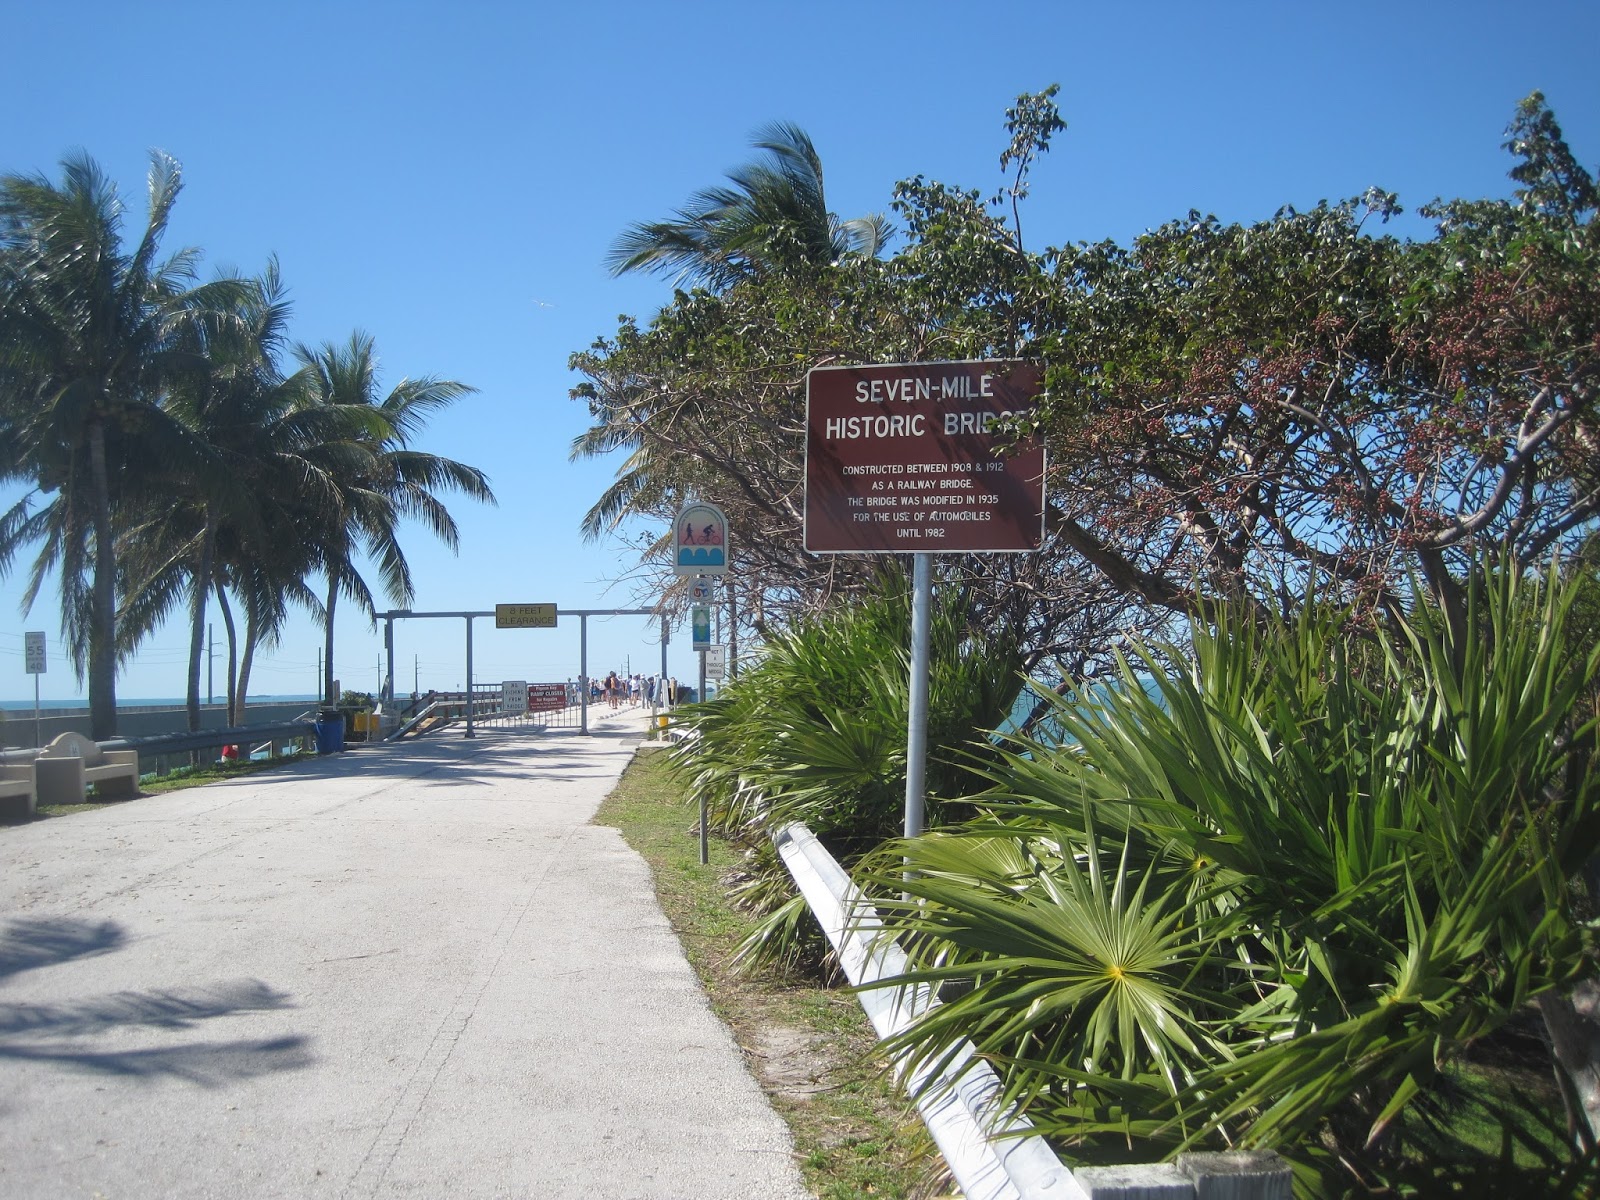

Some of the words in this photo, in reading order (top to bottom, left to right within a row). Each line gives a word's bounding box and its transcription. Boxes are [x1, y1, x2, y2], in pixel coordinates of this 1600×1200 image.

[855, 375, 994, 403] SEVEN-MILE
[826, 414, 926, 439] HISTORIC
[943, 410, 1027, 436] BRID
[842, 464, 904, 475] CONSTRUCTED
[906, 463, 948, 474] BETWEEN
[950, 463, 972, 472] 1908
[975, 463, 983, 472] &
[985, 462, 1004, 472] 1912
[871, 481, 884, 490] AS
[887, 481, 894, 490] A
[897, 479, 937, 490] RAILWAY
[940, 479, 974, 489] BRIDGE.
[847, 497, 864, 507] THE
[866, 497, 898, 506] BRIDGE
[900, 496, 920, 506] WAS
[923, 495, 964, 505] MODIFIED
[966, 495, 975, 505] IN
[978, 494, 999, 504] 1935
[853, 512, 870, 522] FOR
[873, 512, 890, 521] THE
[893, 512, 910, 521] USE
[913, 512, 926, 521] OF
[928, 510, 991, 521] AUTOMOBILES
[896, 528, 921, 538] UNTIL
[924, 528, 945, 538] 1982
[510, 607, 515, 615] 8
[519, 606, 543, 615] FEET
[498, 616, 554, 625] CLEARANCE
[27, 646, 44, 656] 55
[30, 662, 42, 670] 40
